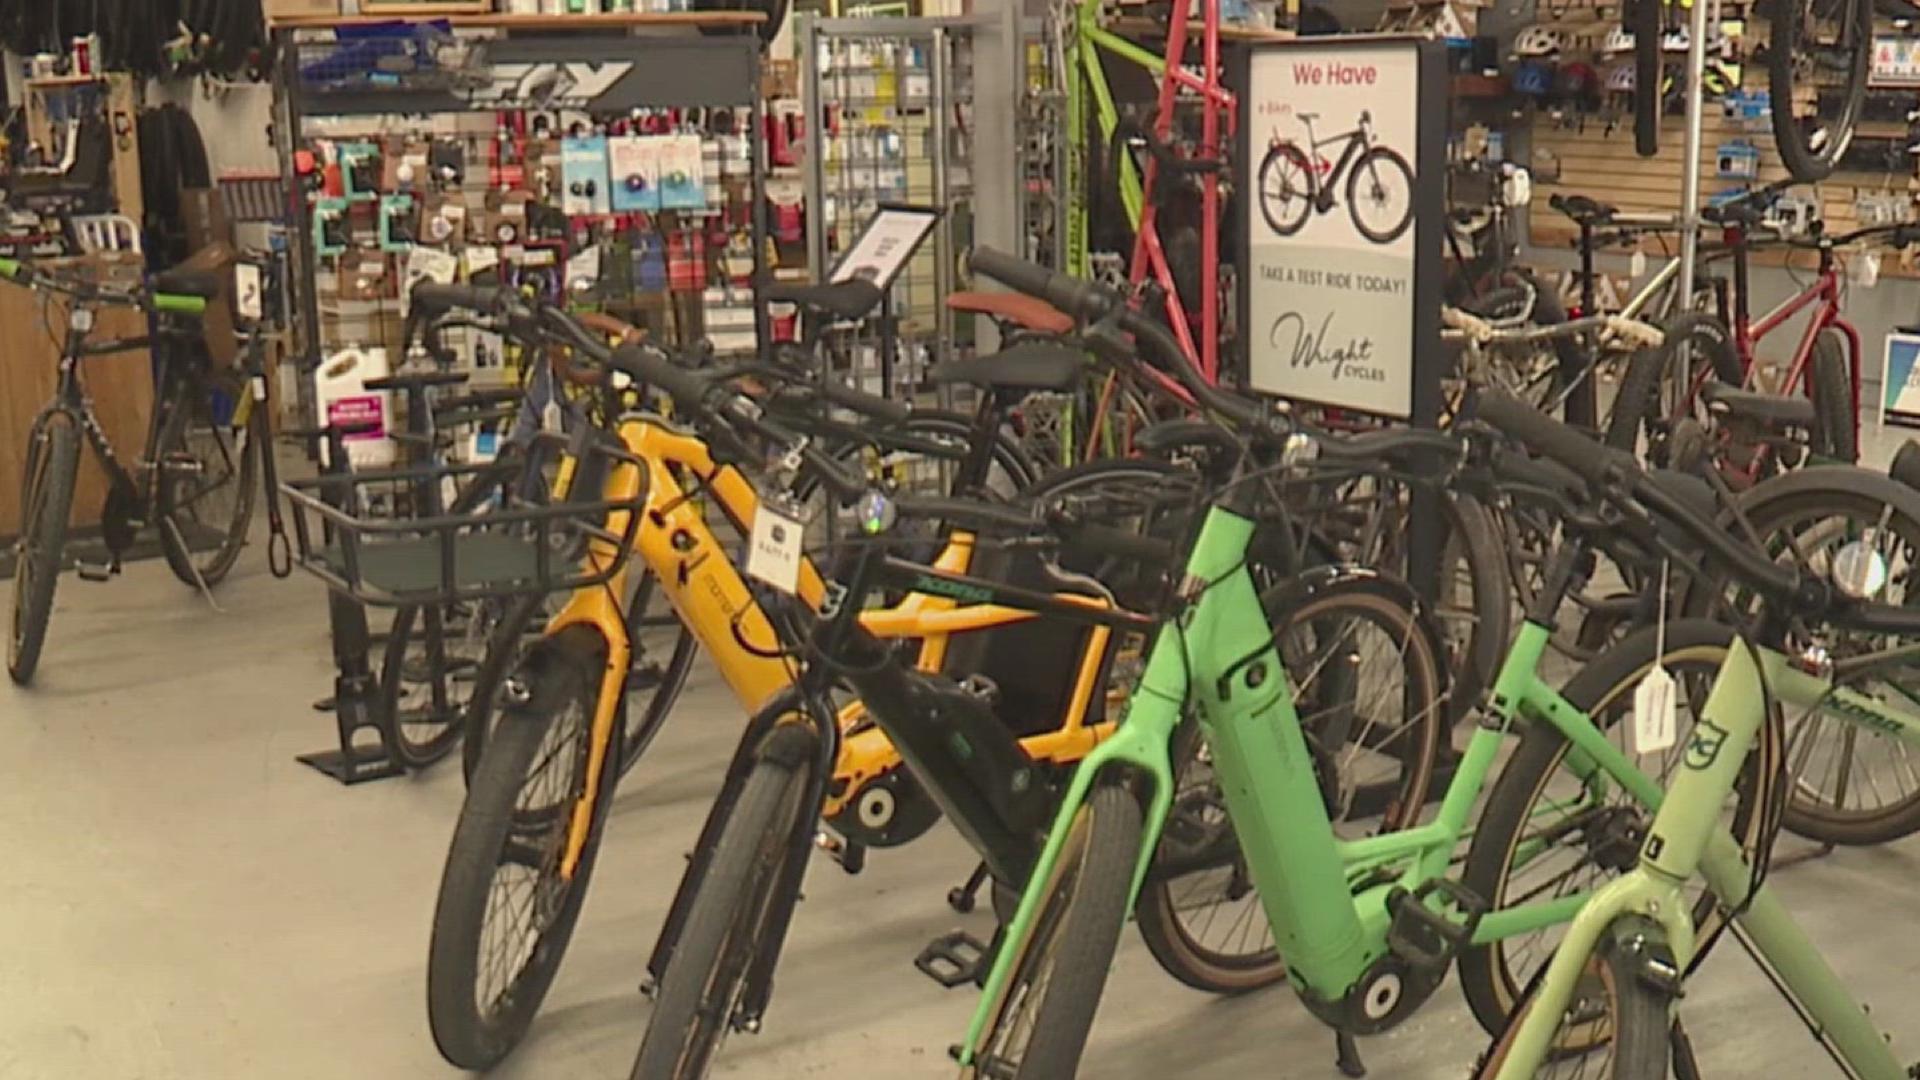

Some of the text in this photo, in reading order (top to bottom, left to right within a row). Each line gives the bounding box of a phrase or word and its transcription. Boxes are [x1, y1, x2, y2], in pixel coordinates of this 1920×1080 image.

[1293, 64, 1377, 86] We Have
[1260, 265, 1407, 295] TAKE A TEST RIDE TODAY!
[1270, 310, 1373, 381] Wright
[1344, 366, 1386, 382] CYCLES
